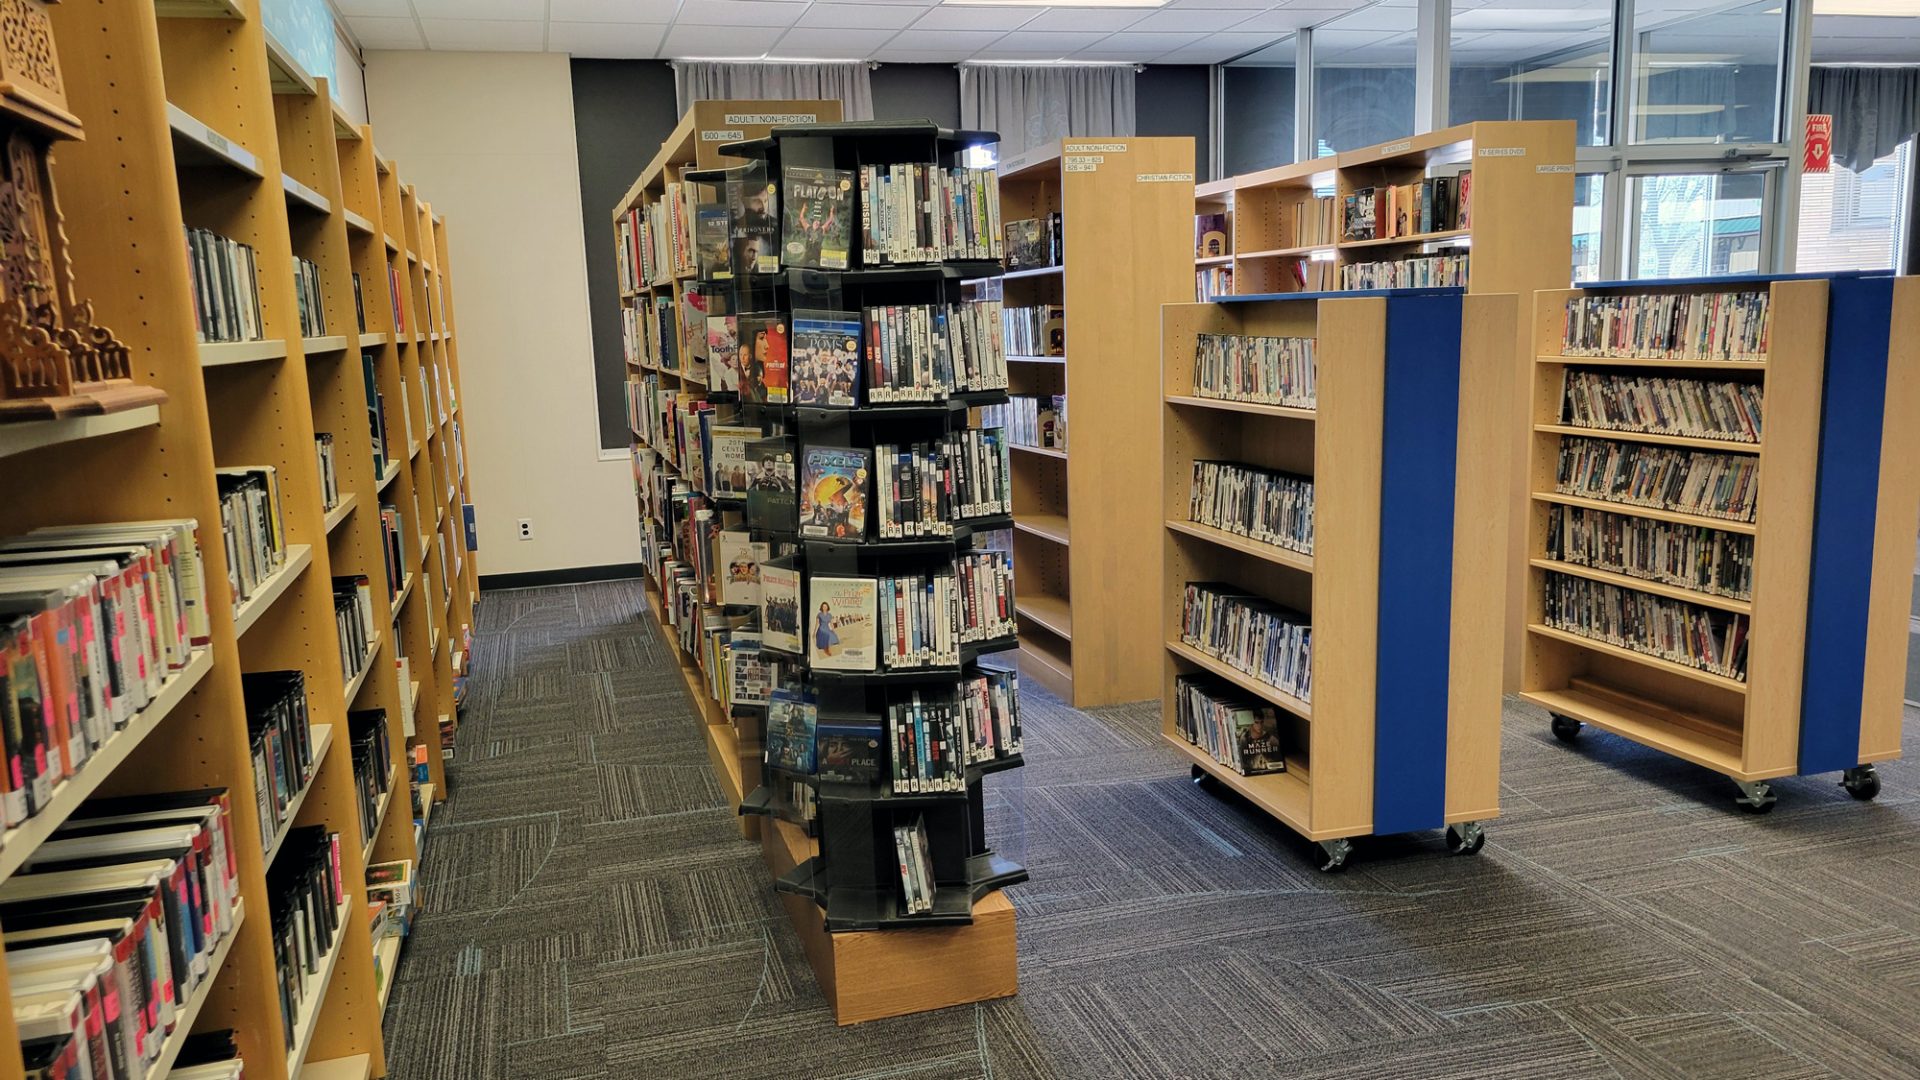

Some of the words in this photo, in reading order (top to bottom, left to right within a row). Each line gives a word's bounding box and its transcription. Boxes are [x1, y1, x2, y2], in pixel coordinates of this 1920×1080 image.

[728, 115, 755, 124] ADULT
[760, 115, 814, 123] NON-FICTION
[704, 132, 718, 140] 600
[728, 131, 742, 139] 645
[793, 184, 844, 201] PLATOON
[810, 338, 842, 350] POMS
[808, 454, 864, 468] PIXELS
[1244, 746, 1278, 755] RUNNER
[851, 758, 876, 766] PLACE
